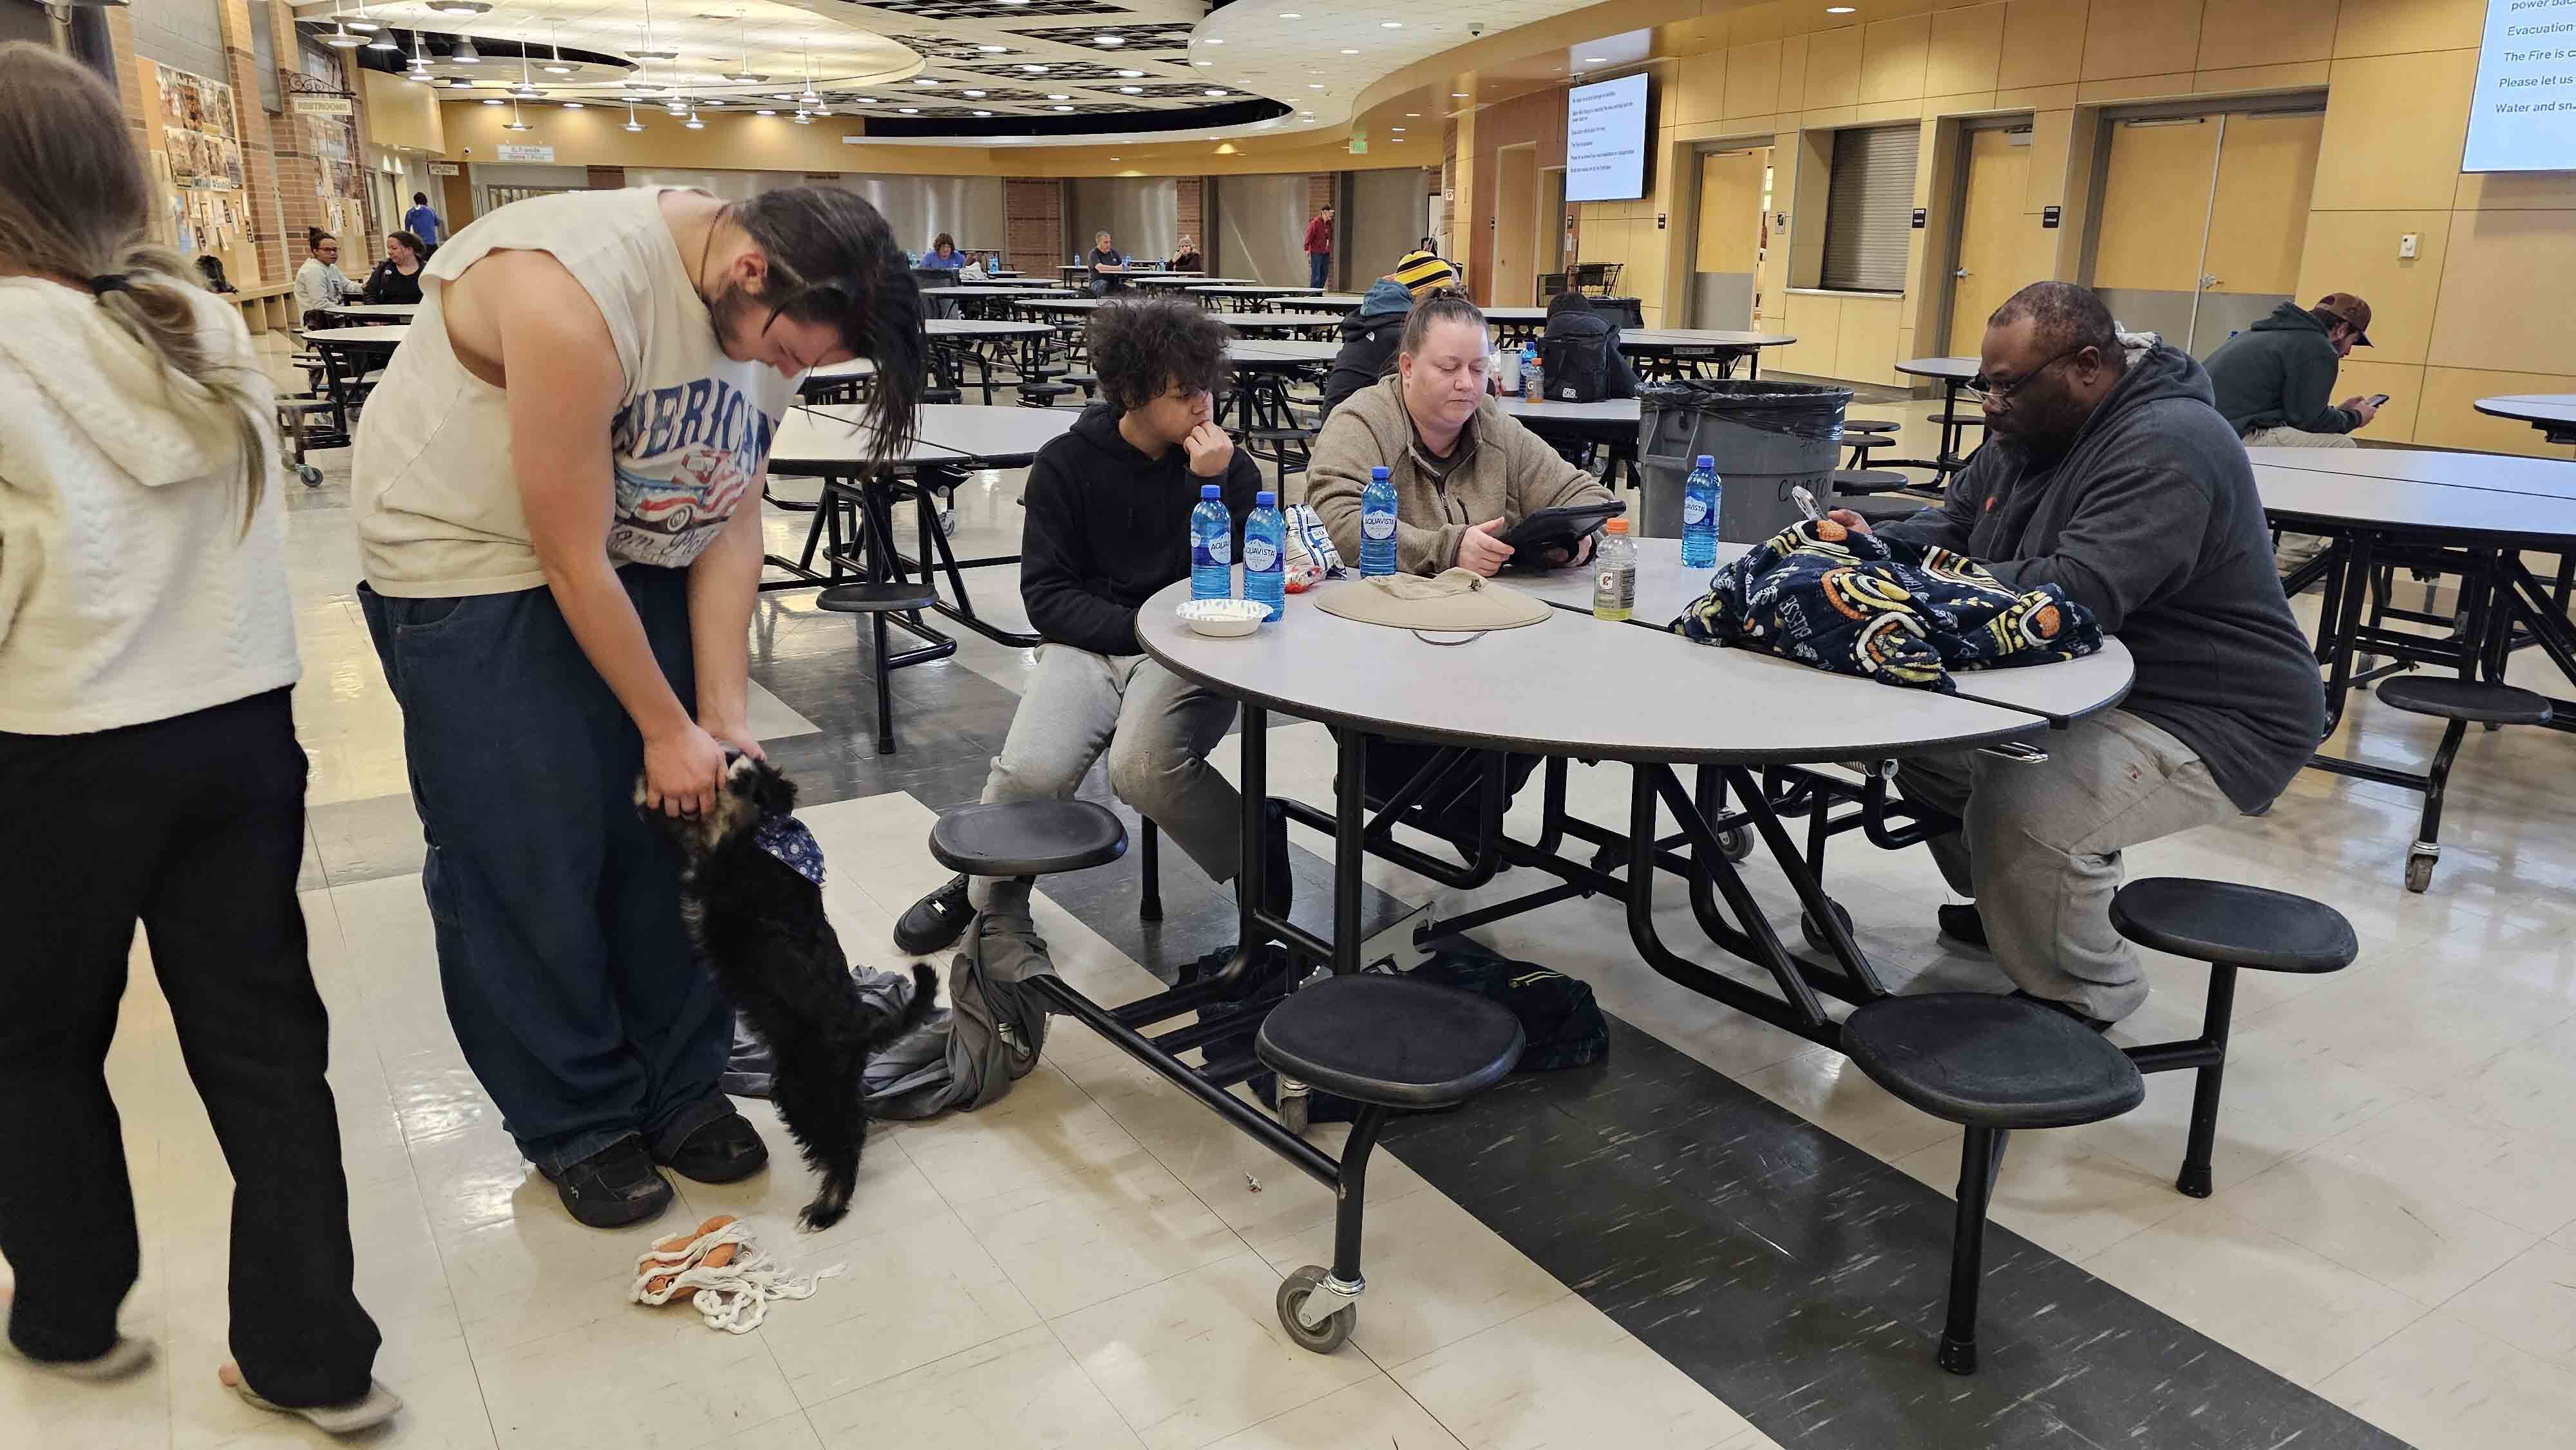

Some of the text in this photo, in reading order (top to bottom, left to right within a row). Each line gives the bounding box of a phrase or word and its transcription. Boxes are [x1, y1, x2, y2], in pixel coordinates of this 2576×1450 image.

[2511, 0, 2548, 12] power
[2508, 23, 2573, 36] Evacuation
[2504, 52, 2525, 62] The
[2528, 50, 2552, 61] Fire
[2555, 48, 2564, 58] is
[2499, 78, 2538, 88] Please
[2541, 75, 2556, 85] let
[2496, 104, 2530, 113] Water
[2533, 101, 2556, 111] and
[1527, 381, 1534, 390] G
[1600, 572, 1613, 590] G
